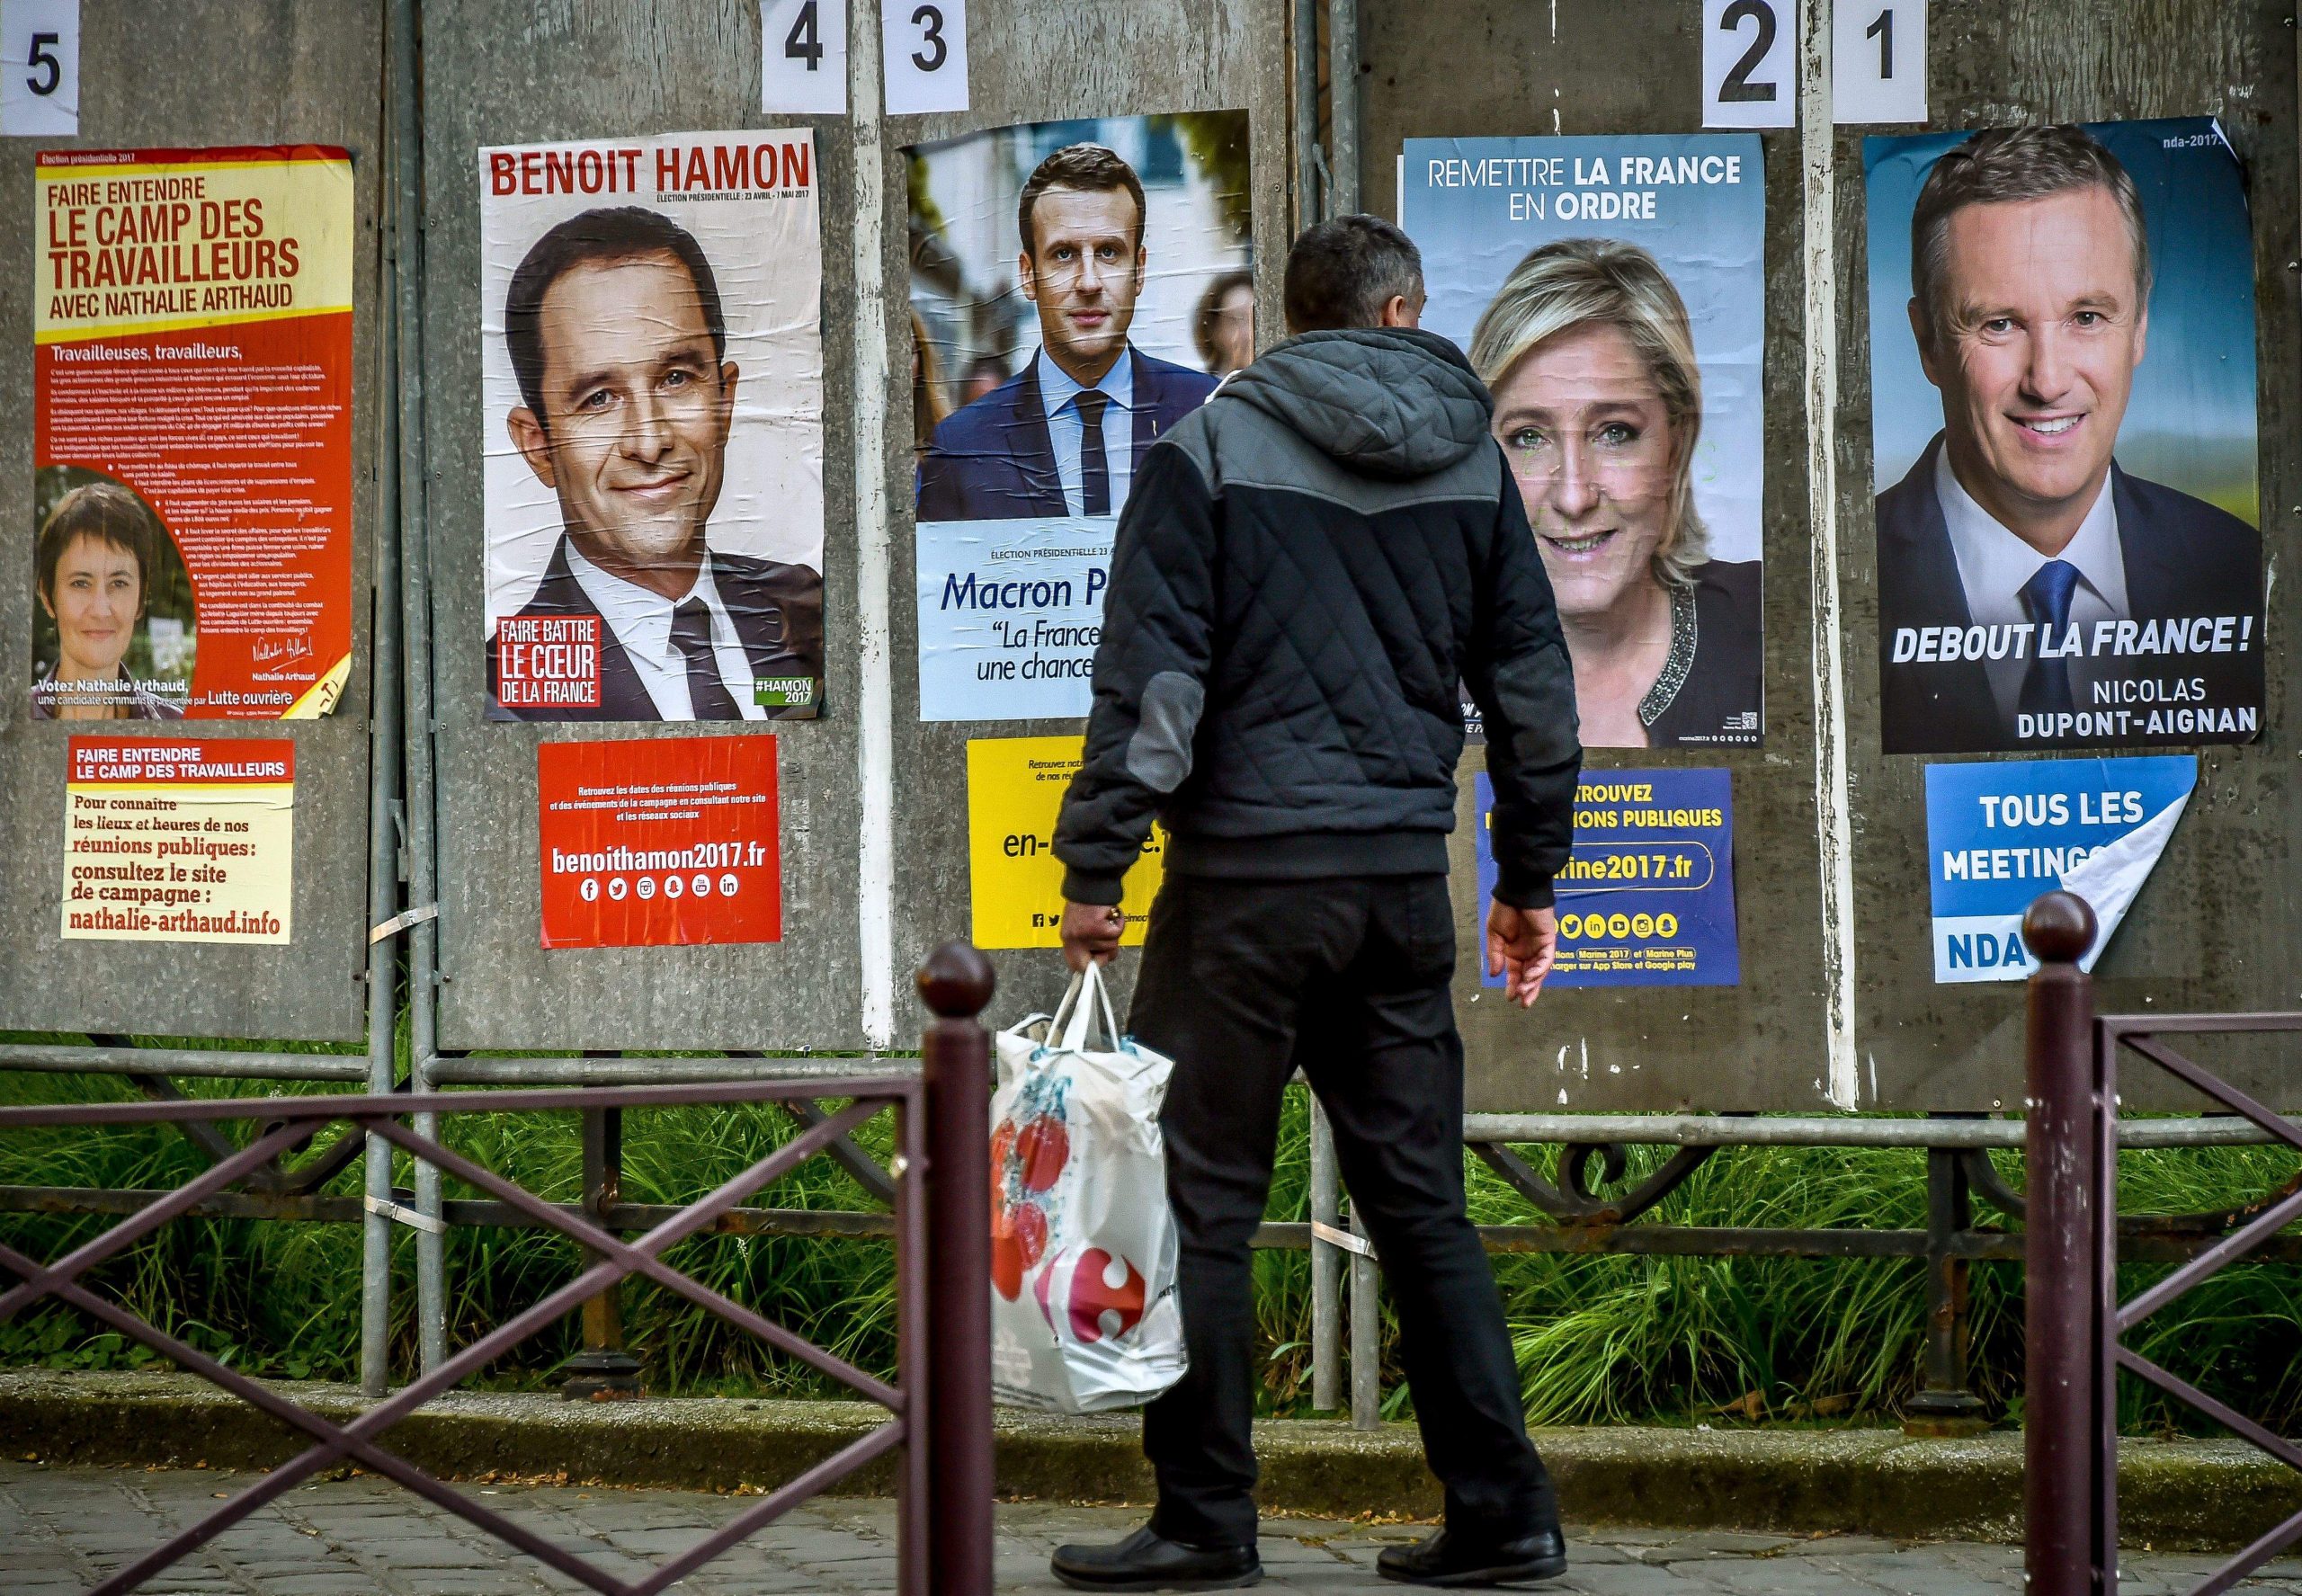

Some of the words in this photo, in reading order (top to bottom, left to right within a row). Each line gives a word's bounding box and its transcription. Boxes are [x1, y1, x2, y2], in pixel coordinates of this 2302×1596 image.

[785, 0, 823, 71] 4
[911, 4, 947, 72] 3
[1867, 9, 1892, 79] 1
[1718, 0, 1777, 102] 2
[27, 31, 60, 94] 5
[2164, 135, 2225, 148] nda-2017.
[71, 154, 116, 165] présidentielle
[119, 153, 135, 162] 2017
[490, 148, 642, 196] BENOIT
[656, 143, 808, 192] HAMON
[1429, 158, 1564, 187] REMETTRE
[1575, 157, 1610, 185] LA
[1620, 156, 1740, 184] FRANCE
[48, 183, 101, 207] FAIRE
[107, 176, 205, 203] ENTENDRE
[656, 191, 687, 202] ÉLECTION
[689, 191, 740, 201] PRÉSIDENTIELLE
[745, 192, 752, 201] 23
[754, 192, 772, 200] AVRIL
[777, 191, 781, 199] 7
[781, 191, 794, 199] MAI
[795, 190, 809, 198] 2017
[1510, 193, 1545, 221] EN
[1555, 192, 1656, 220] ORDRE
[49, 210, 86, 247] LE
[96, 202, 191, 245] CAMP
[201, 198, 263, 240] DES
[48, 238, 299, 289] TRAVAILLEURS
[49, 295, 99, 319] AVEC
[105, 288, 195, 317] NATHALIE
[202, 283, 292, 311] ARTHAUD
[51, 345, 151, 361] Travailleuses,
[156, 343, 243, 360] travailleurs,
[991, 549, 1031, 559] ÉLECTION
[1034, 548, 1096, 557] PRÉSIDENTIELLE
[941, 572, 1072, 610] Macron
[502, 620, 539, 643] FAIRE
[543, 620, 594, 642] BATTRE
[1034, 620, 1101, 646] France
[1892, 622, 2034, 663] DEBOUT
[2039, 621, 2083, 658] LA
[503, 645, 525, 678] LE
[531, 645, 594, 678] CŒUR
[977, 661, 1015, 680] une
[1022, 652, 1093, 679] chance
[38, 680, 74, 692] Votez
[76, 680, 130, 692] Nathalie
[134, 680, 189, 693] Arthaud,
[253, 673, 283, 681] Nathalie
[285, 673, 315, 681] Arthaud
[755, 680, 811, 691] #HAMON
[38, 696, 55, 705] une
[58, 695, 101, 705] candidate
[103, 695, 155, 705] communiste
[157, 695, 192, 707] présentée
[194, 697, 206, 706] par
[209, 691, 239, 705] Lutte
[243, 690, 292, 704] ouvrière
[503, 682, 519, 703] DE
[522, 682, 540, 703] LA
[544, 682, 595, 703] FRANCE
[785, 691, 811, 703] 2017
[2093, 678, 2206, 704] NICOLAS
[2018, 707, 2257, 739] DUPONT-AIGNAN
[76, 749, 117, 762] FAIRE
[122, 748, 201, 762] ENTENDRE
[1029, 760, 1065, 770] Retrouvez
[76, 765, 94, 779] LE
[99, 765, 141, 779] CAMP
[146, 764, 174, 777] DES
[179, 762, 285, 777] TRAVAILLEURS
[1036, 772, 1045, 780] de
[578, 787, 615, 796] Retrouvez
[616, 787, 627, 795] les
[629, 785, 649, 794] dates
[651, 784, 664, 793] des
[666, 783, 698, 793] réunions
[700, 781, 736, 792] publiques
[75, 796, 105, 809] Pour
[550, 802, 558, 810] et
[558, 801, 572, 810] des
[619, 798, 629, 807] de
[629, 798, 638, 807] la
[639, 798, 677, 808] campagne
[690, 795, 729, 806] consultant
[731, 795, 750, 804] notre
[752, 793, 765, 803] site
[1979, 793, 2069, 827] TOUS
[2080, 791, 2144, 825] LES
[74, 816, 93, 829] les
[97, 816, 132, 829] lieux
[136, 818, 148, 830] et
[153, 817, 200, 832] heures
[204, 818, 220, 832] de
[224, 822, 249, 832] nos
[617, 813, 624, 821] et
[626, 811, 637, 820] les
[638, 810, 668, 820] réseaux
[670, 810, 699, 819] sociaux
[1623, 809, 1722, 827] PUBLIQUES
[73, 836, 152, 853] réunions
[552, 841, 765, 873] benoithamon2017.fr
[1943, 846, 2108, 881] MEETING
[72, 862, 164, 881] consultez
[170, 862, 186, 882] le
[192, 864, 227, 883] site
[71, 881, 94, 899] de
[99, 887, 201, 906] campagne
[70, 907, 280, 935] nathalie-arthaud.info
[1610, 950, 1628, 958] 2017
[1646, 950, 1674, 958] Marine
[1677, 950, 1693, 958] Plus
[1593, 962, 1611, 971] App
[1612, 961, 1633, 969] Store
[1635, 961, 1644, 969] et
[1645, 961, 1675, 971] Google
[1677, 960, 1695, 970] play
